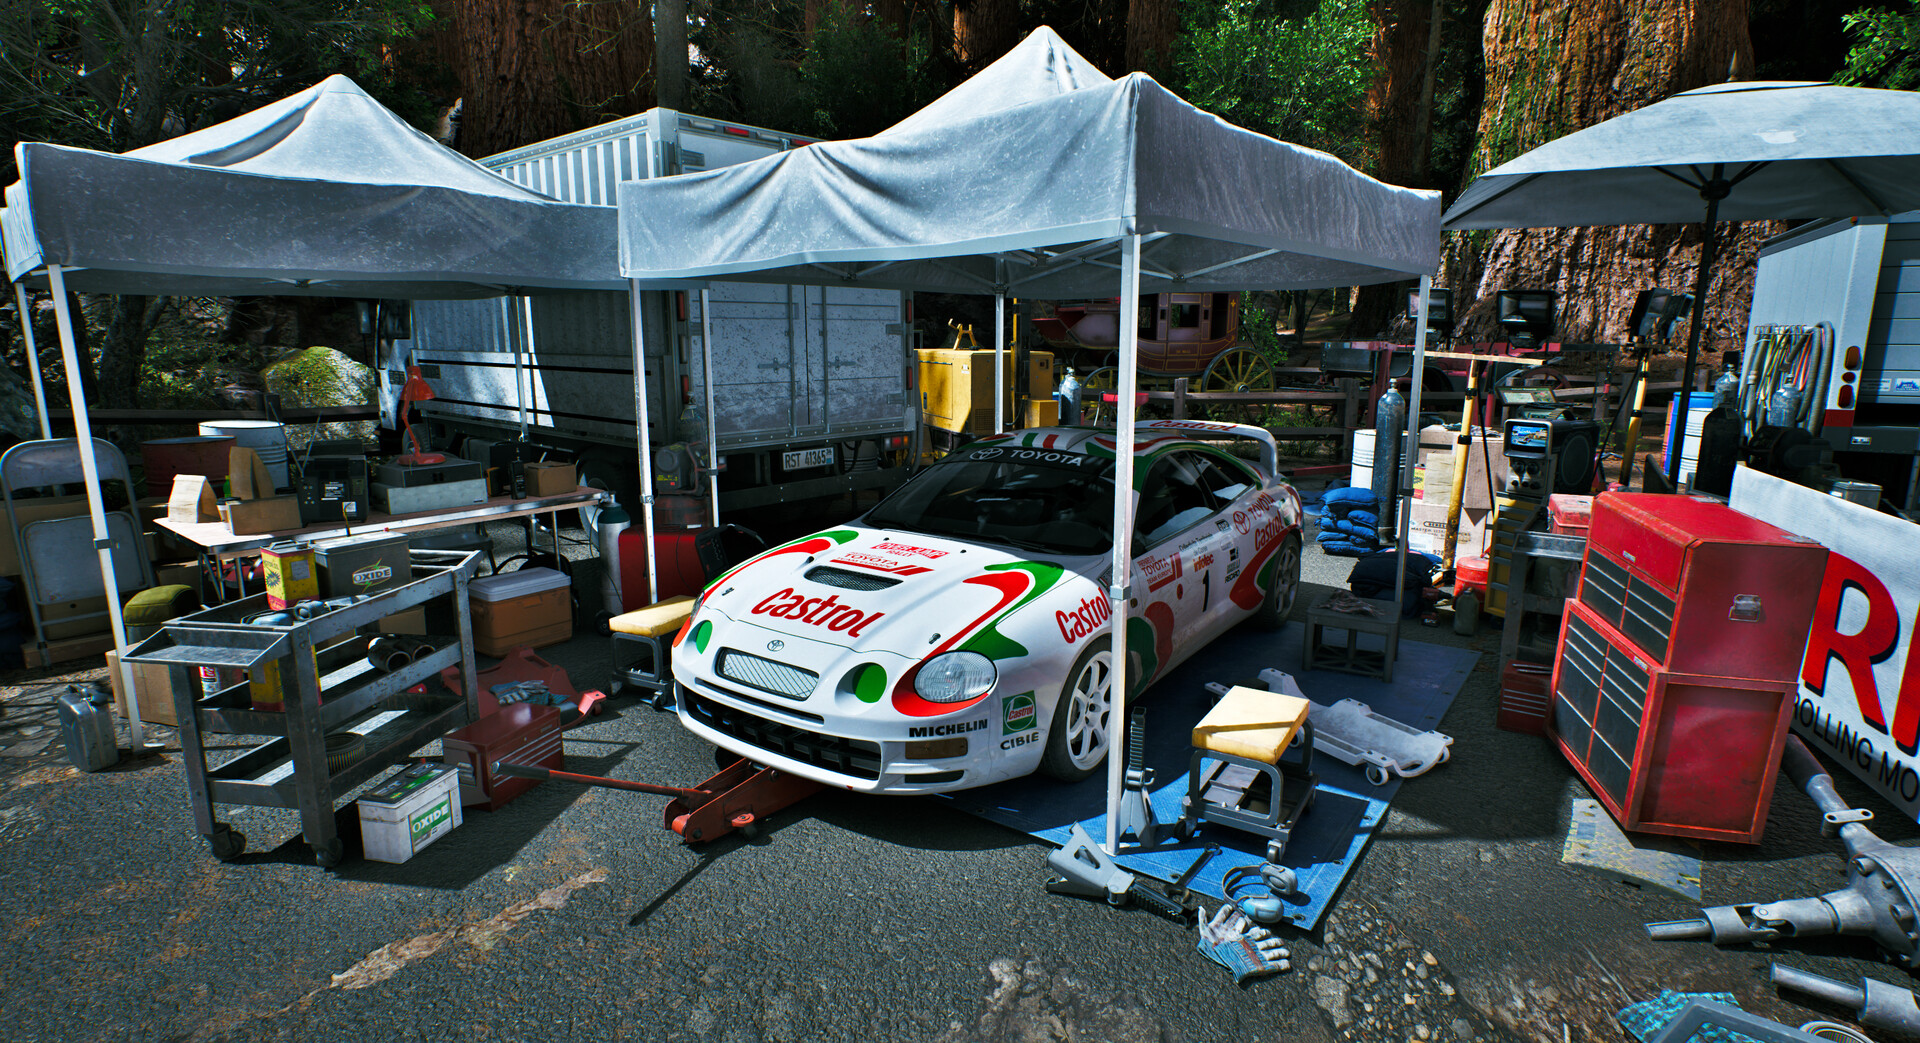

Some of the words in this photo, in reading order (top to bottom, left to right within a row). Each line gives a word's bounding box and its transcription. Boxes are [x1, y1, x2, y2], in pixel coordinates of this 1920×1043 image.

[1149, 420, 1238, 432] Castrol
[784, 453, 801, 469] RST
[805, 450, 826, 466] 41365
[1010, 449, 1082, 467] TOYOTA
[1248, 491, 1276, 520] TOYOTA
[1255, 509, 1284, 551] Castrol
[845, 553, 898, 566] TOYOTA
[1141, 558, 1170, 576] TOYOTA
[353, 568, 391, 583] OXIDE
[1147, 575, 1158, 584] TEAM
[1202, 569, 1210, 612] 1
[750, 587, 886, 638] Castrol
[1055, 586, 1113, 644] Castrol
[1801, 550, 1920, 757] R
[1008, 704, 1034, 721] Castrol
[909, 719, 988, 738] MICHELIN
[1000, 732, 1039, 750] CIBIE
[1879, 751, 1920, 802] MO
[412, 803, 449, 833] OXIDE
